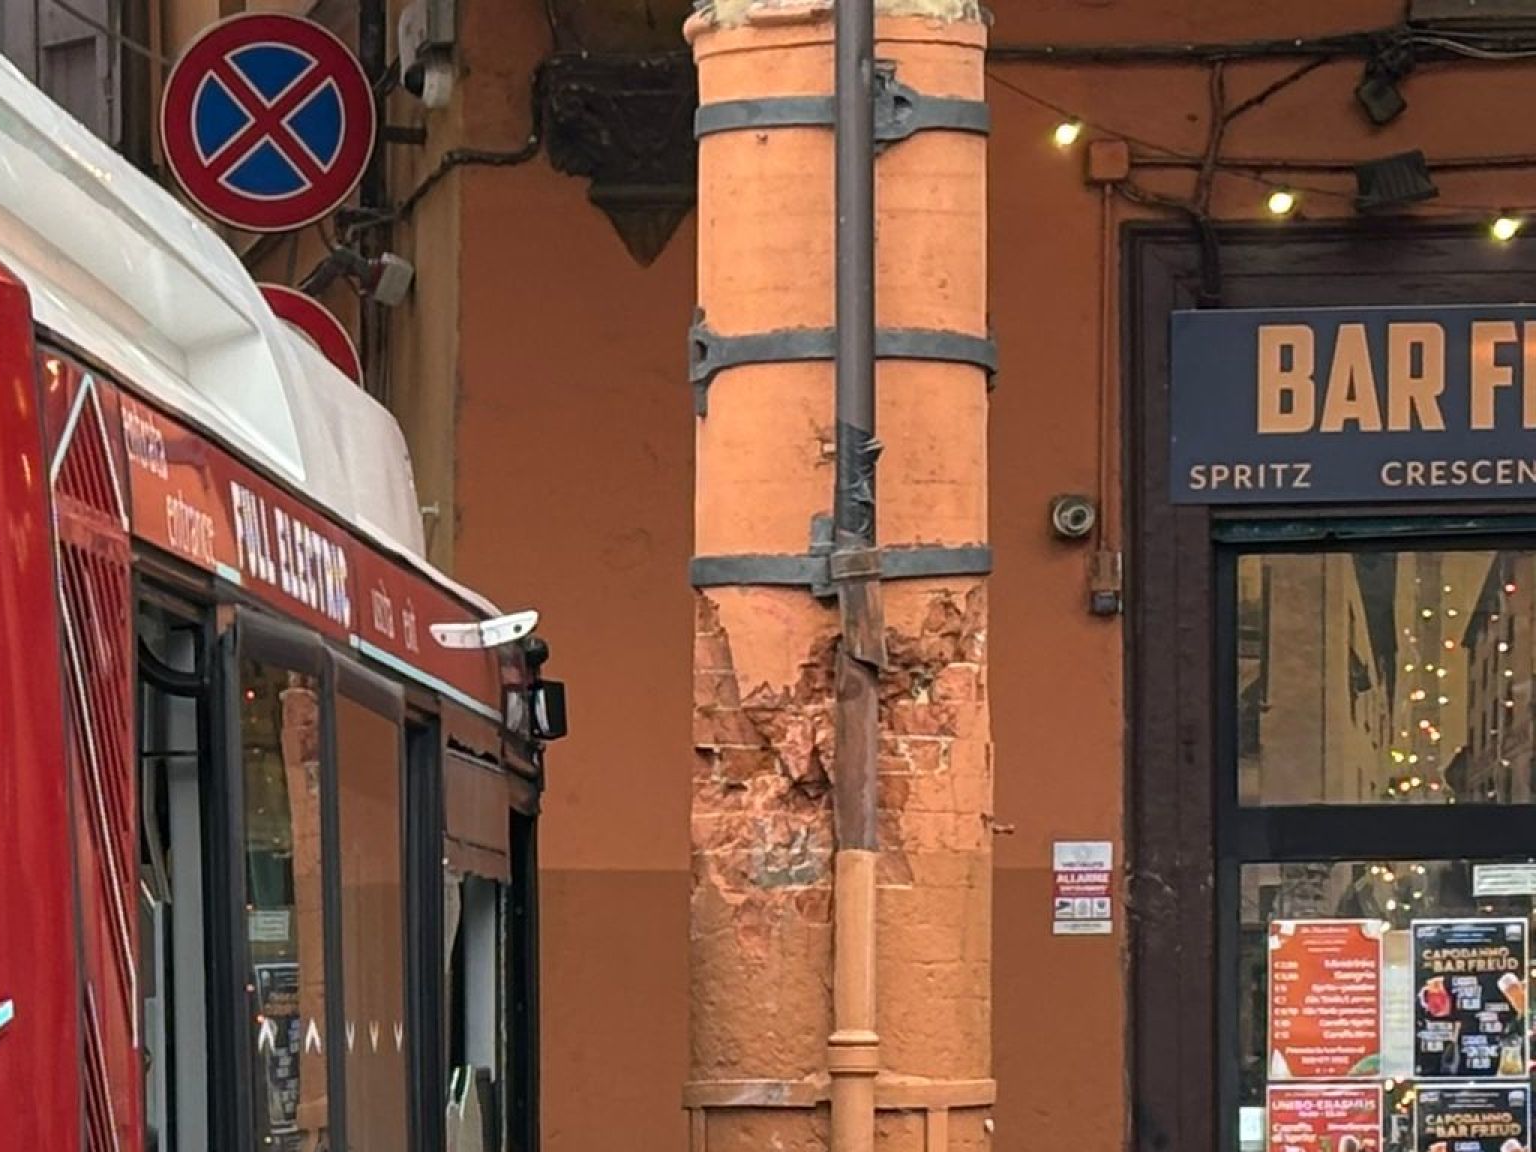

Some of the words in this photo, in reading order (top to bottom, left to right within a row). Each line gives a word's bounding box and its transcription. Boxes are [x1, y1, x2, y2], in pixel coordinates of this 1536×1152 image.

[1257, 322, 1447, 434] BAR
[1469, 320, 1536, 431] F
[1189, 463, 1312, 490] SPRITZ
[230, 480, 277, 586] FULL
[275, 506, 351, 629] ELECTRIC
